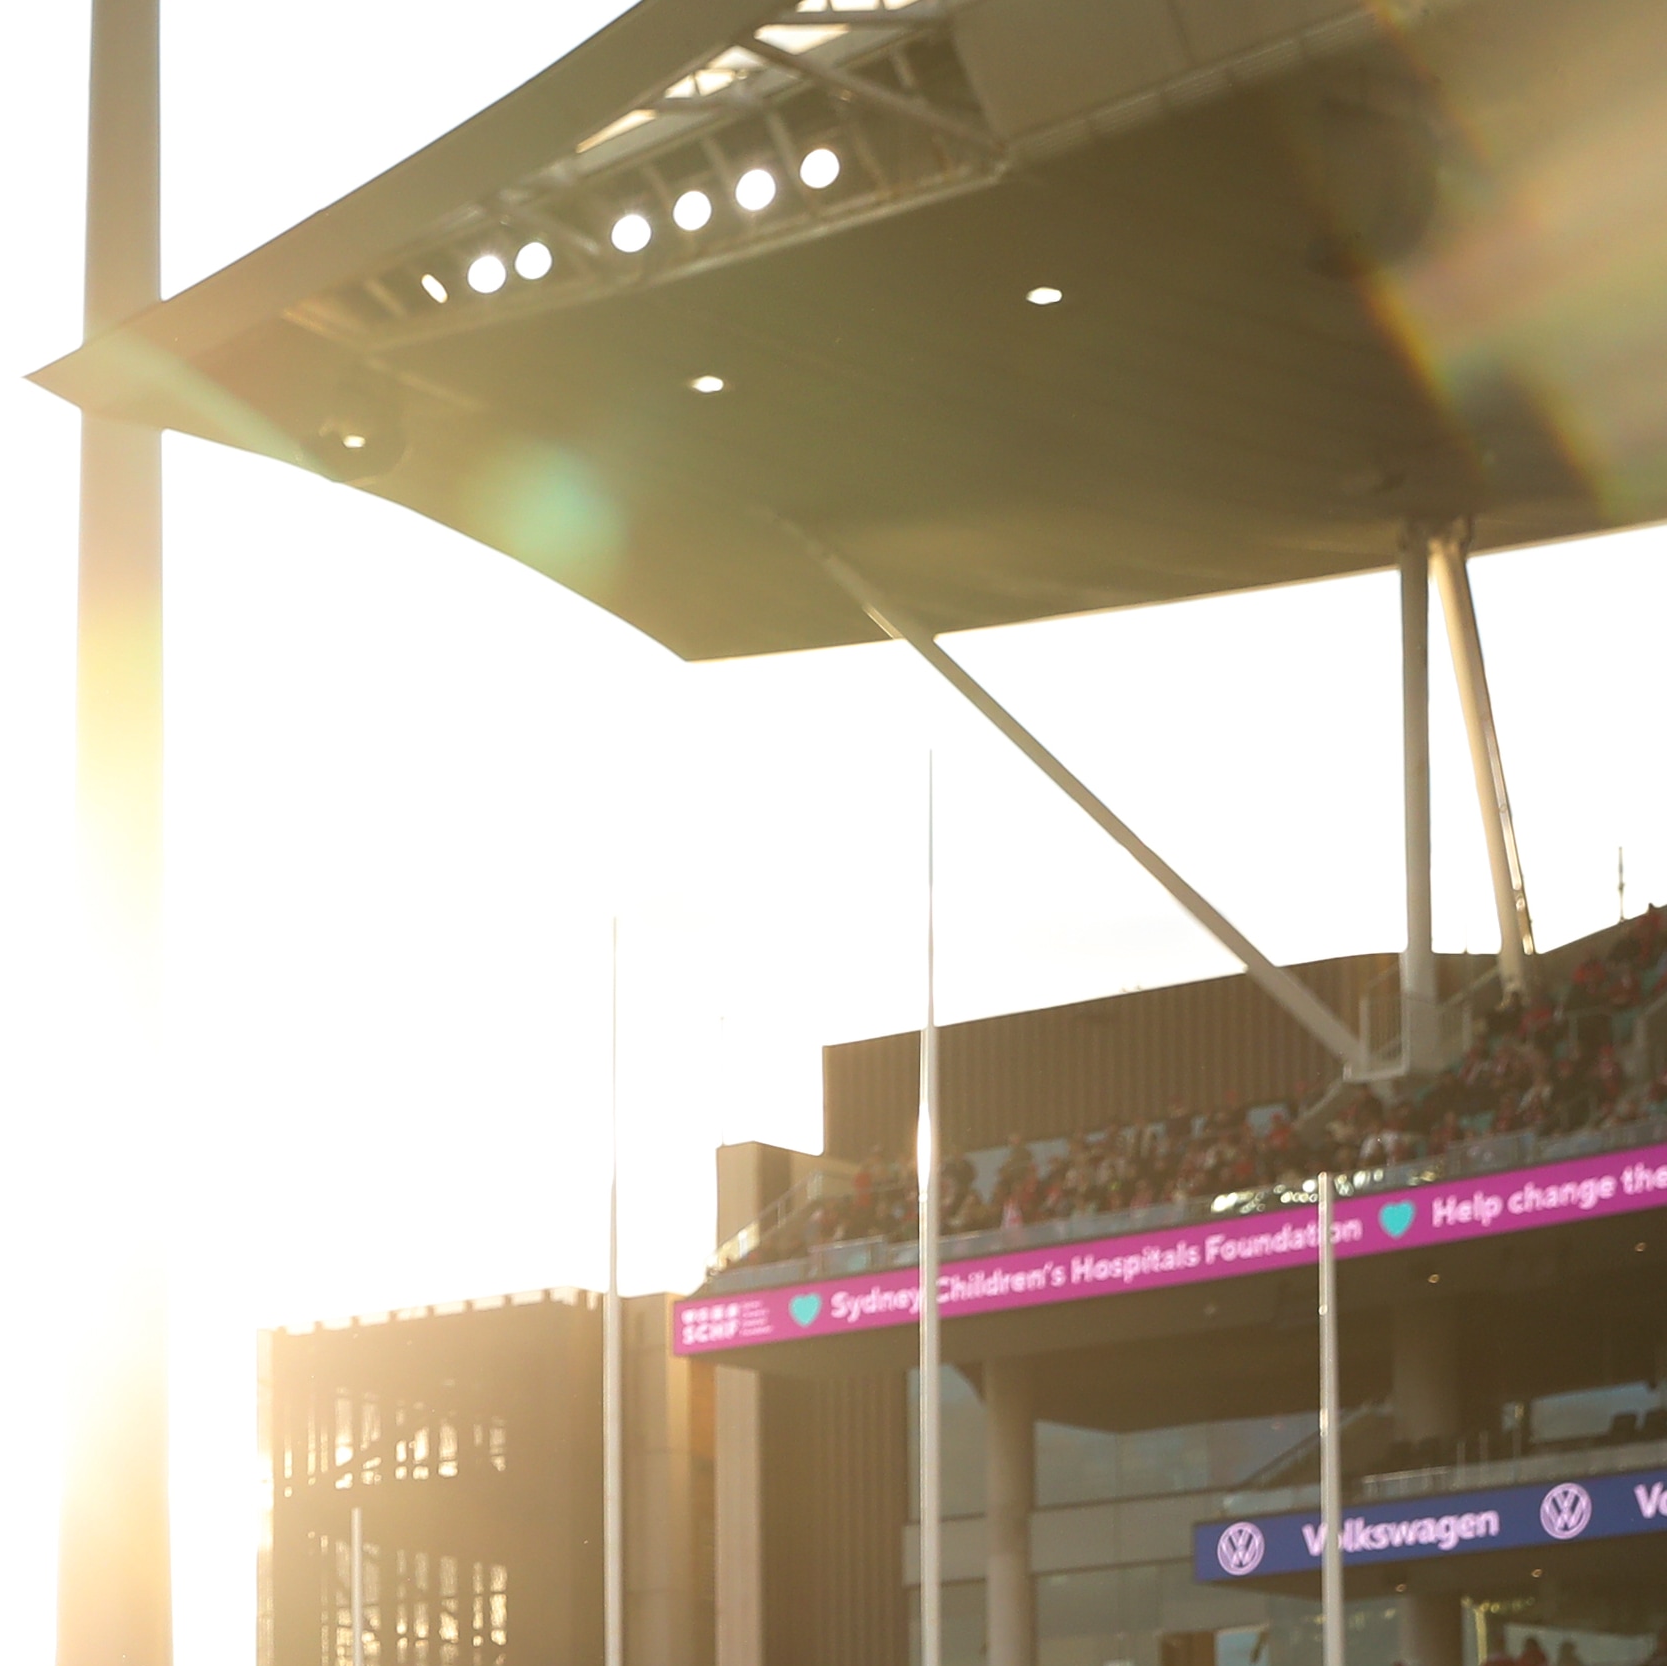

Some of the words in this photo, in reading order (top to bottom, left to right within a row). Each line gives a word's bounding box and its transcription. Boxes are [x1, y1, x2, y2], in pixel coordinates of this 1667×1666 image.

[1433, 1190, 1503, 1227] Help
[1507, 1175, 1617, 1213] change
[831, 1286, 920, 1322] Sydney
[1071, 1241, 1201, 1283] Hospitals
[1205, 1219, 1363, 1264] Foundaton
[1302, 1510, 1499, 1556] Vlkswagen
